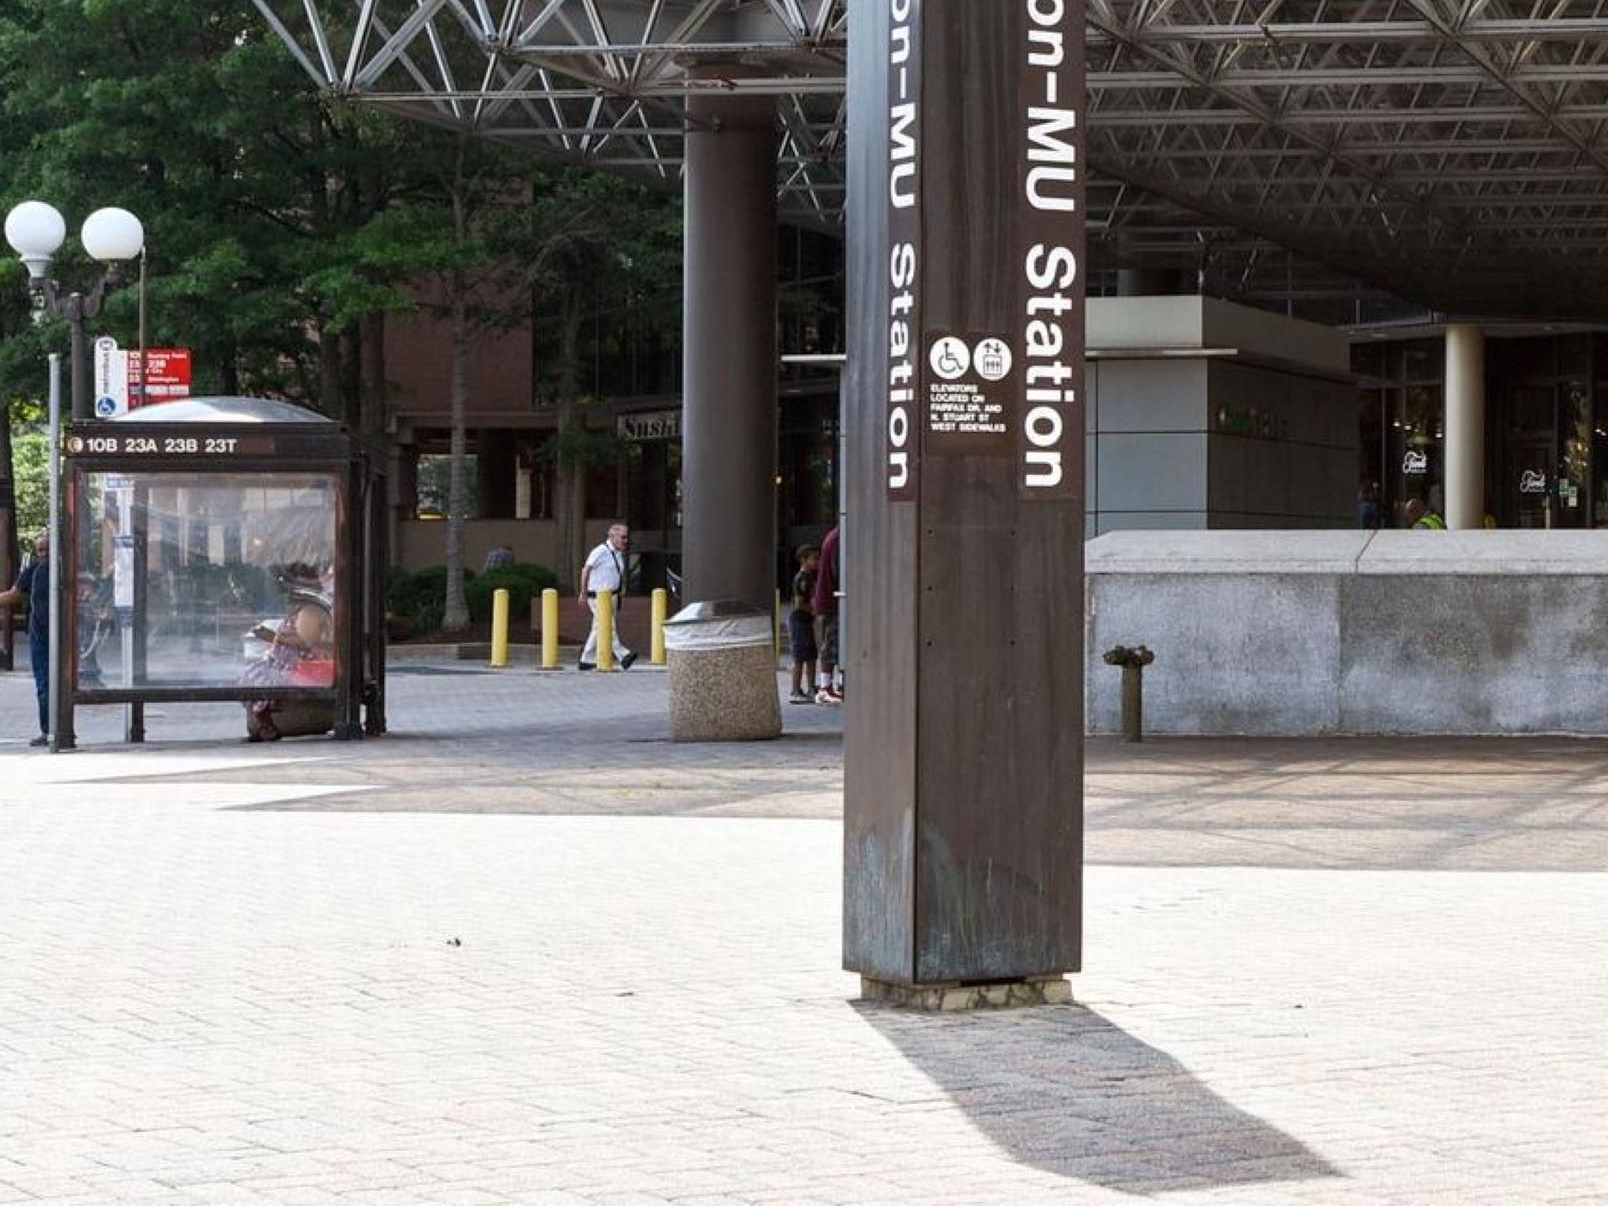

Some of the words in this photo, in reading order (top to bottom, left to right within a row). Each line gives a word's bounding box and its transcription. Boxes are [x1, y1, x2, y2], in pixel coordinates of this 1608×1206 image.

[889, 242, 917, 488] Station
[1024, 244, 1076, 488] Station
[930, 393, 968, 402] LOCATED
[930, 423, 956, 432] WEST
[959, 423, 1007, 432] SIDEWALKS
[87, 438, 118, 453] 10B
[125, 438, 158, 453] 23A
[165, 438, 198, 453] 23B
[204, 438, 237, 453] 23T
